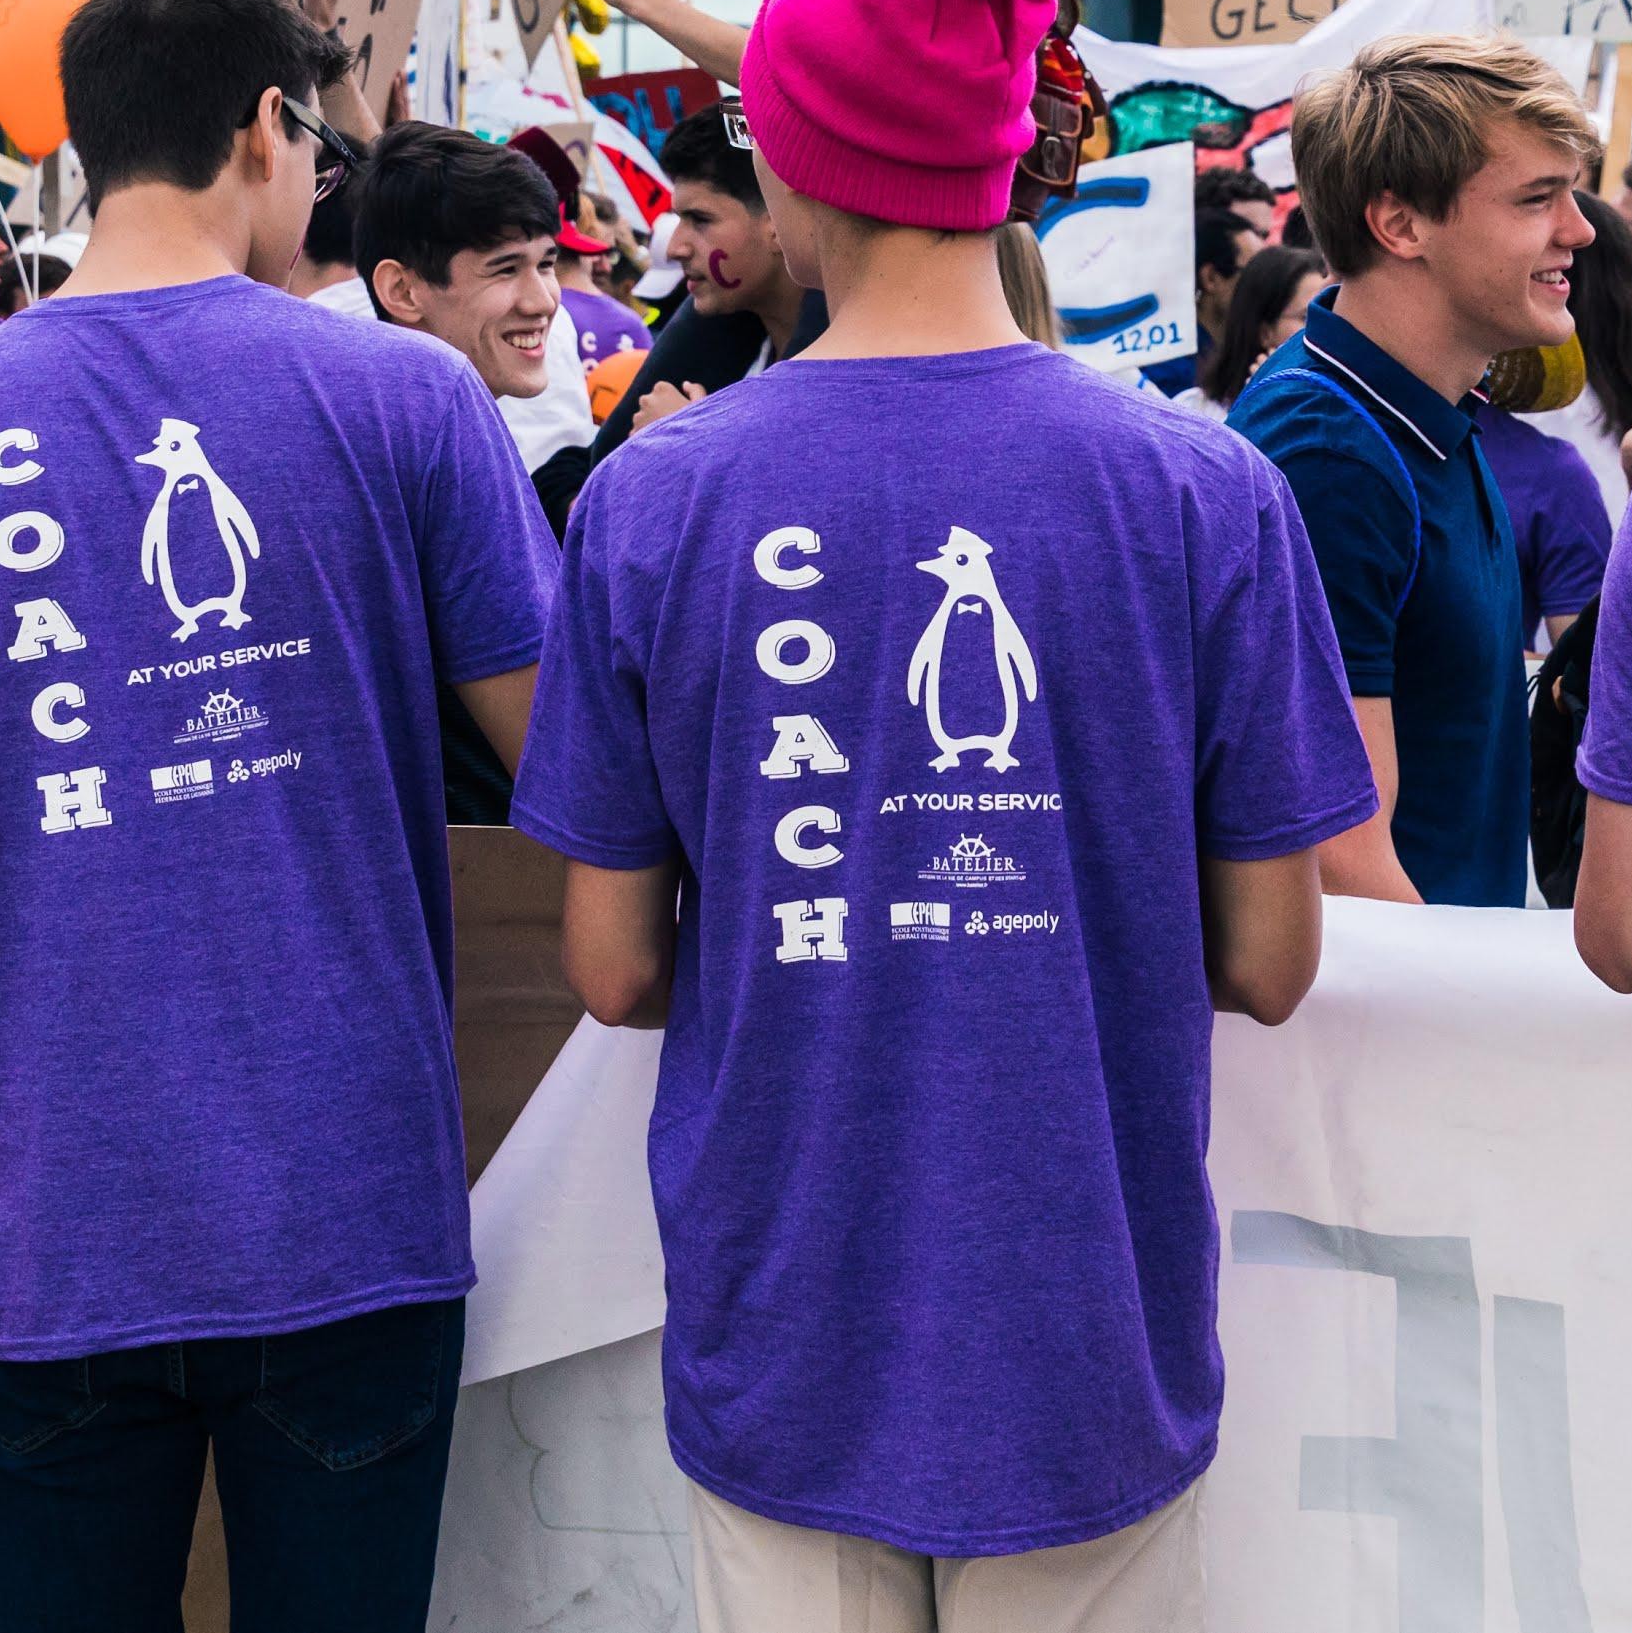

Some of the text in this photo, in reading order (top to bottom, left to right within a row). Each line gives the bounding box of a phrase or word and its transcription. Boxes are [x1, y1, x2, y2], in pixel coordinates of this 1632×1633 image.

[126, 638, 311, 686] AT YOUR SERVICE
[186, 705, 261, 733] BATELIER
[753, 525, 850, 964] COACH
[251, 748, 302, 777] agepoly
[879, 793, 1063, 814] AT YOUR SERVIC
[932, 856, 1016, 871] BATELIER
[993, 910, 1059, 934] agepoly
